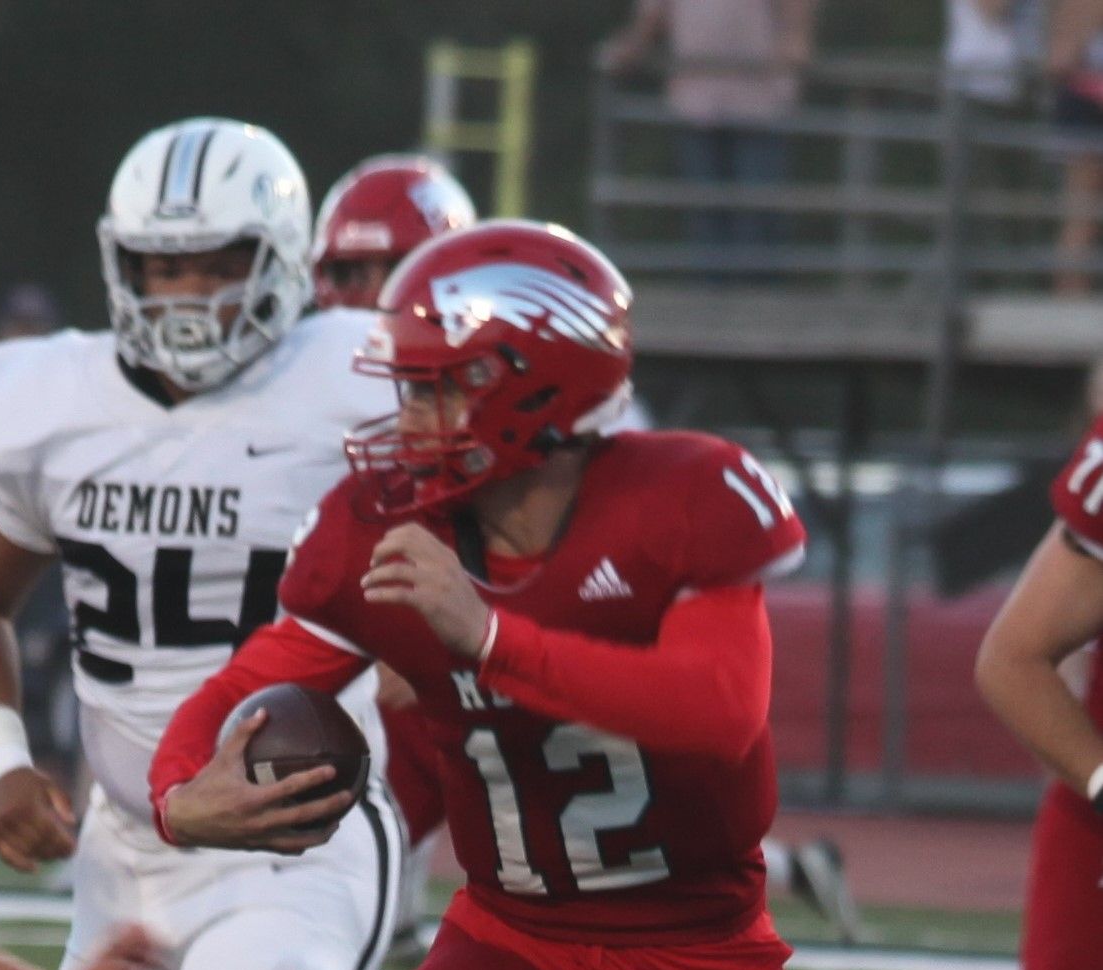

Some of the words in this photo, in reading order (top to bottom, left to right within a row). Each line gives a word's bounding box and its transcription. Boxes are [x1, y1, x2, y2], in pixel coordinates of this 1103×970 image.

[74, 478, 241, 539] DEMONS
[55, 536, 289, 686] 24
[463, 722, 671, 895] 12
